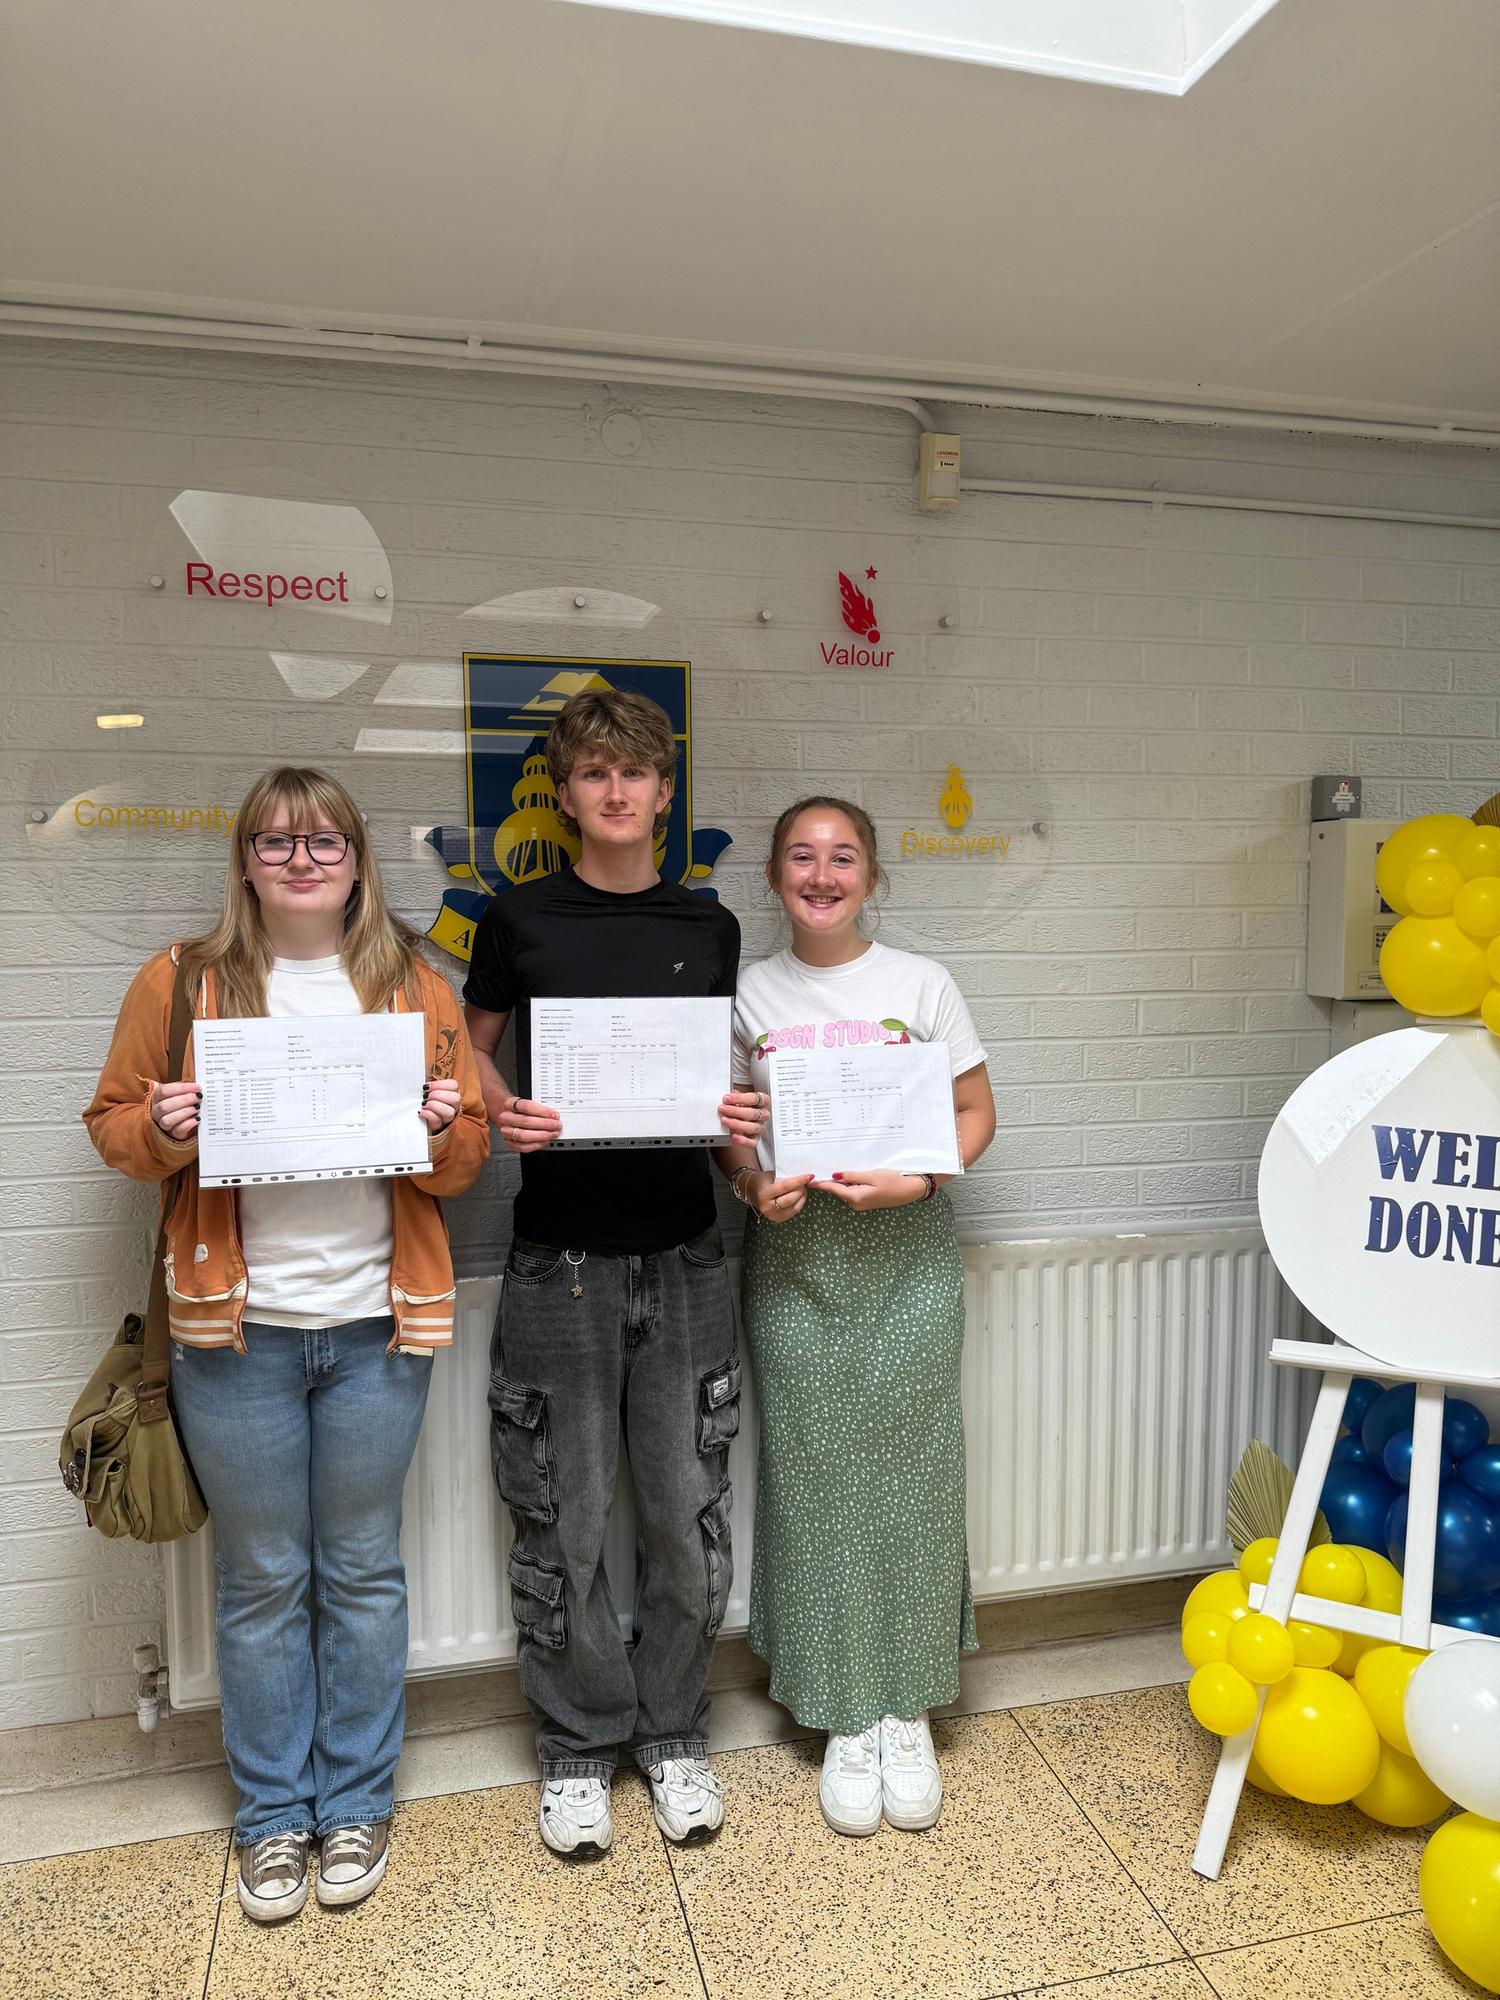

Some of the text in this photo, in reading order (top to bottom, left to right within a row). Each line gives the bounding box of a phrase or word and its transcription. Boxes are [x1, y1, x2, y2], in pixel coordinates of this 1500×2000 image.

[186, 563, 349, 607] Respect
[820, 642, 894, 667] Valour
[74, 800, 240, 838] Community
[901, 831, 1011, 858] Discovery
[767, 1019, 891, 1049] DSGN STUDIO
[1365, 1196, 1500, 1267] DONE
